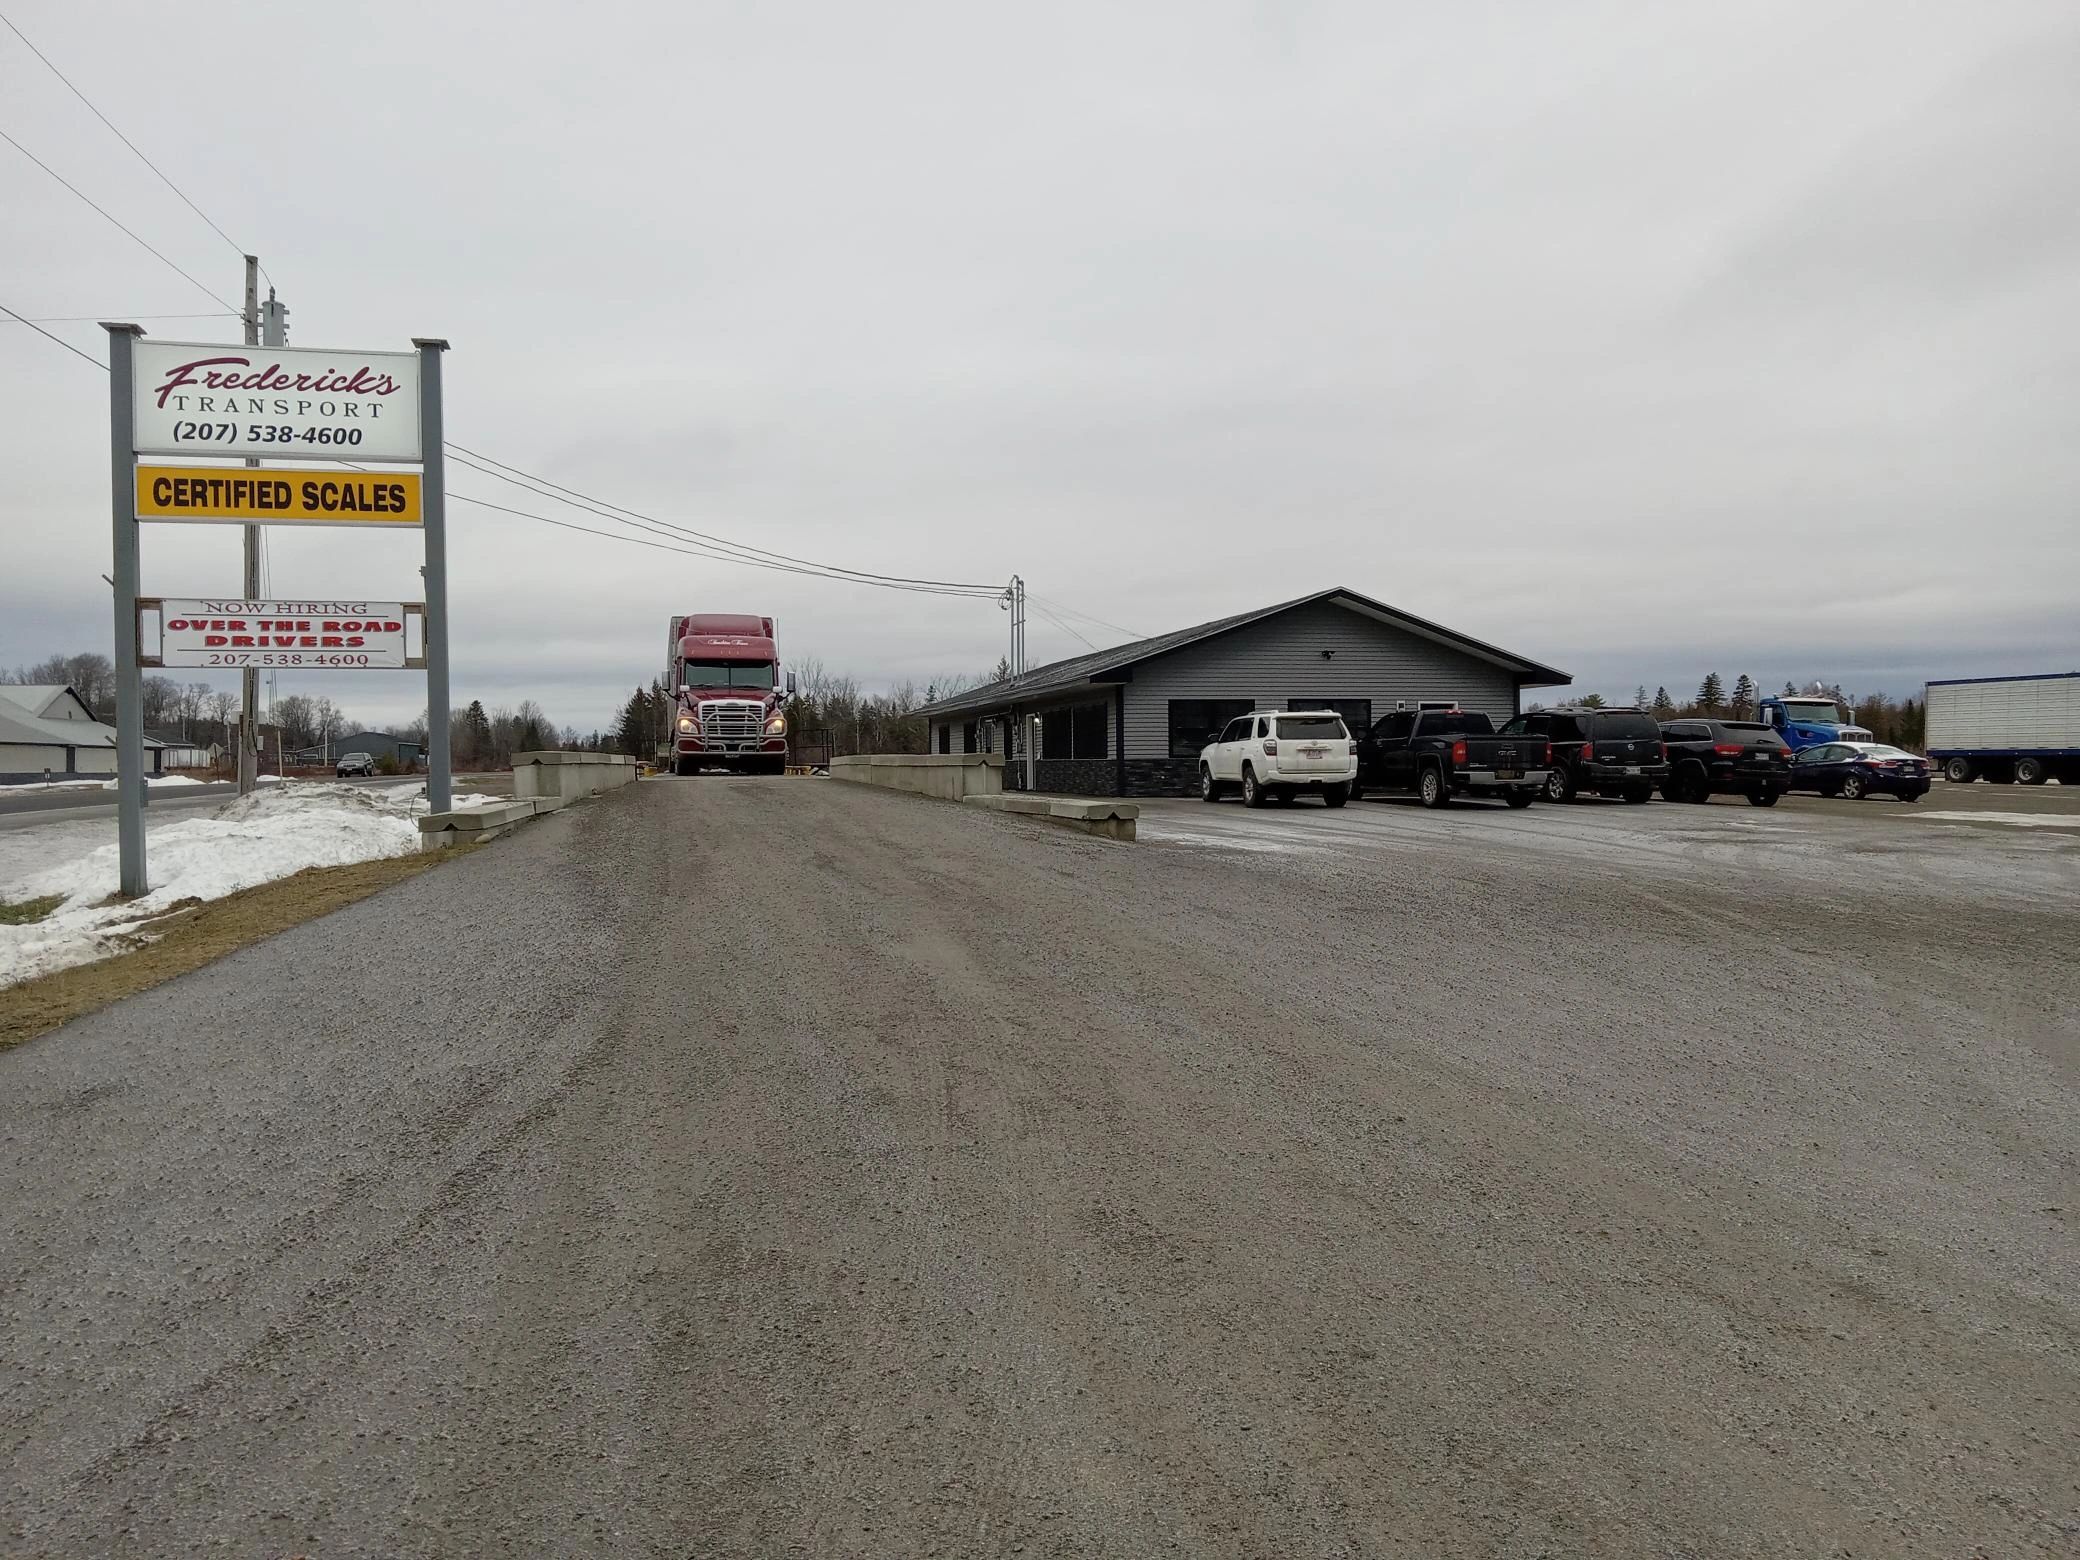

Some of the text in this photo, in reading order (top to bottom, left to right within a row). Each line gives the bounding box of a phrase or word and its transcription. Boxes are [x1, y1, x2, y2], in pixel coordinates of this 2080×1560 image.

[154, 357, 401, 409] Frederick's
[172, 395, 384, 418] TRANSPORT
[173, 421, 363, 446] (207) 538-4600
[152, 477, 406, 514] CERTIFIED SCALES
[205, 602, 368, 615] NOW HIRING
[167, 619, 402, 633] OVER THE ROAD
[204, 635, 366, 648] DRIVERS
[208, 653, 369, 666] 207-538-4600
